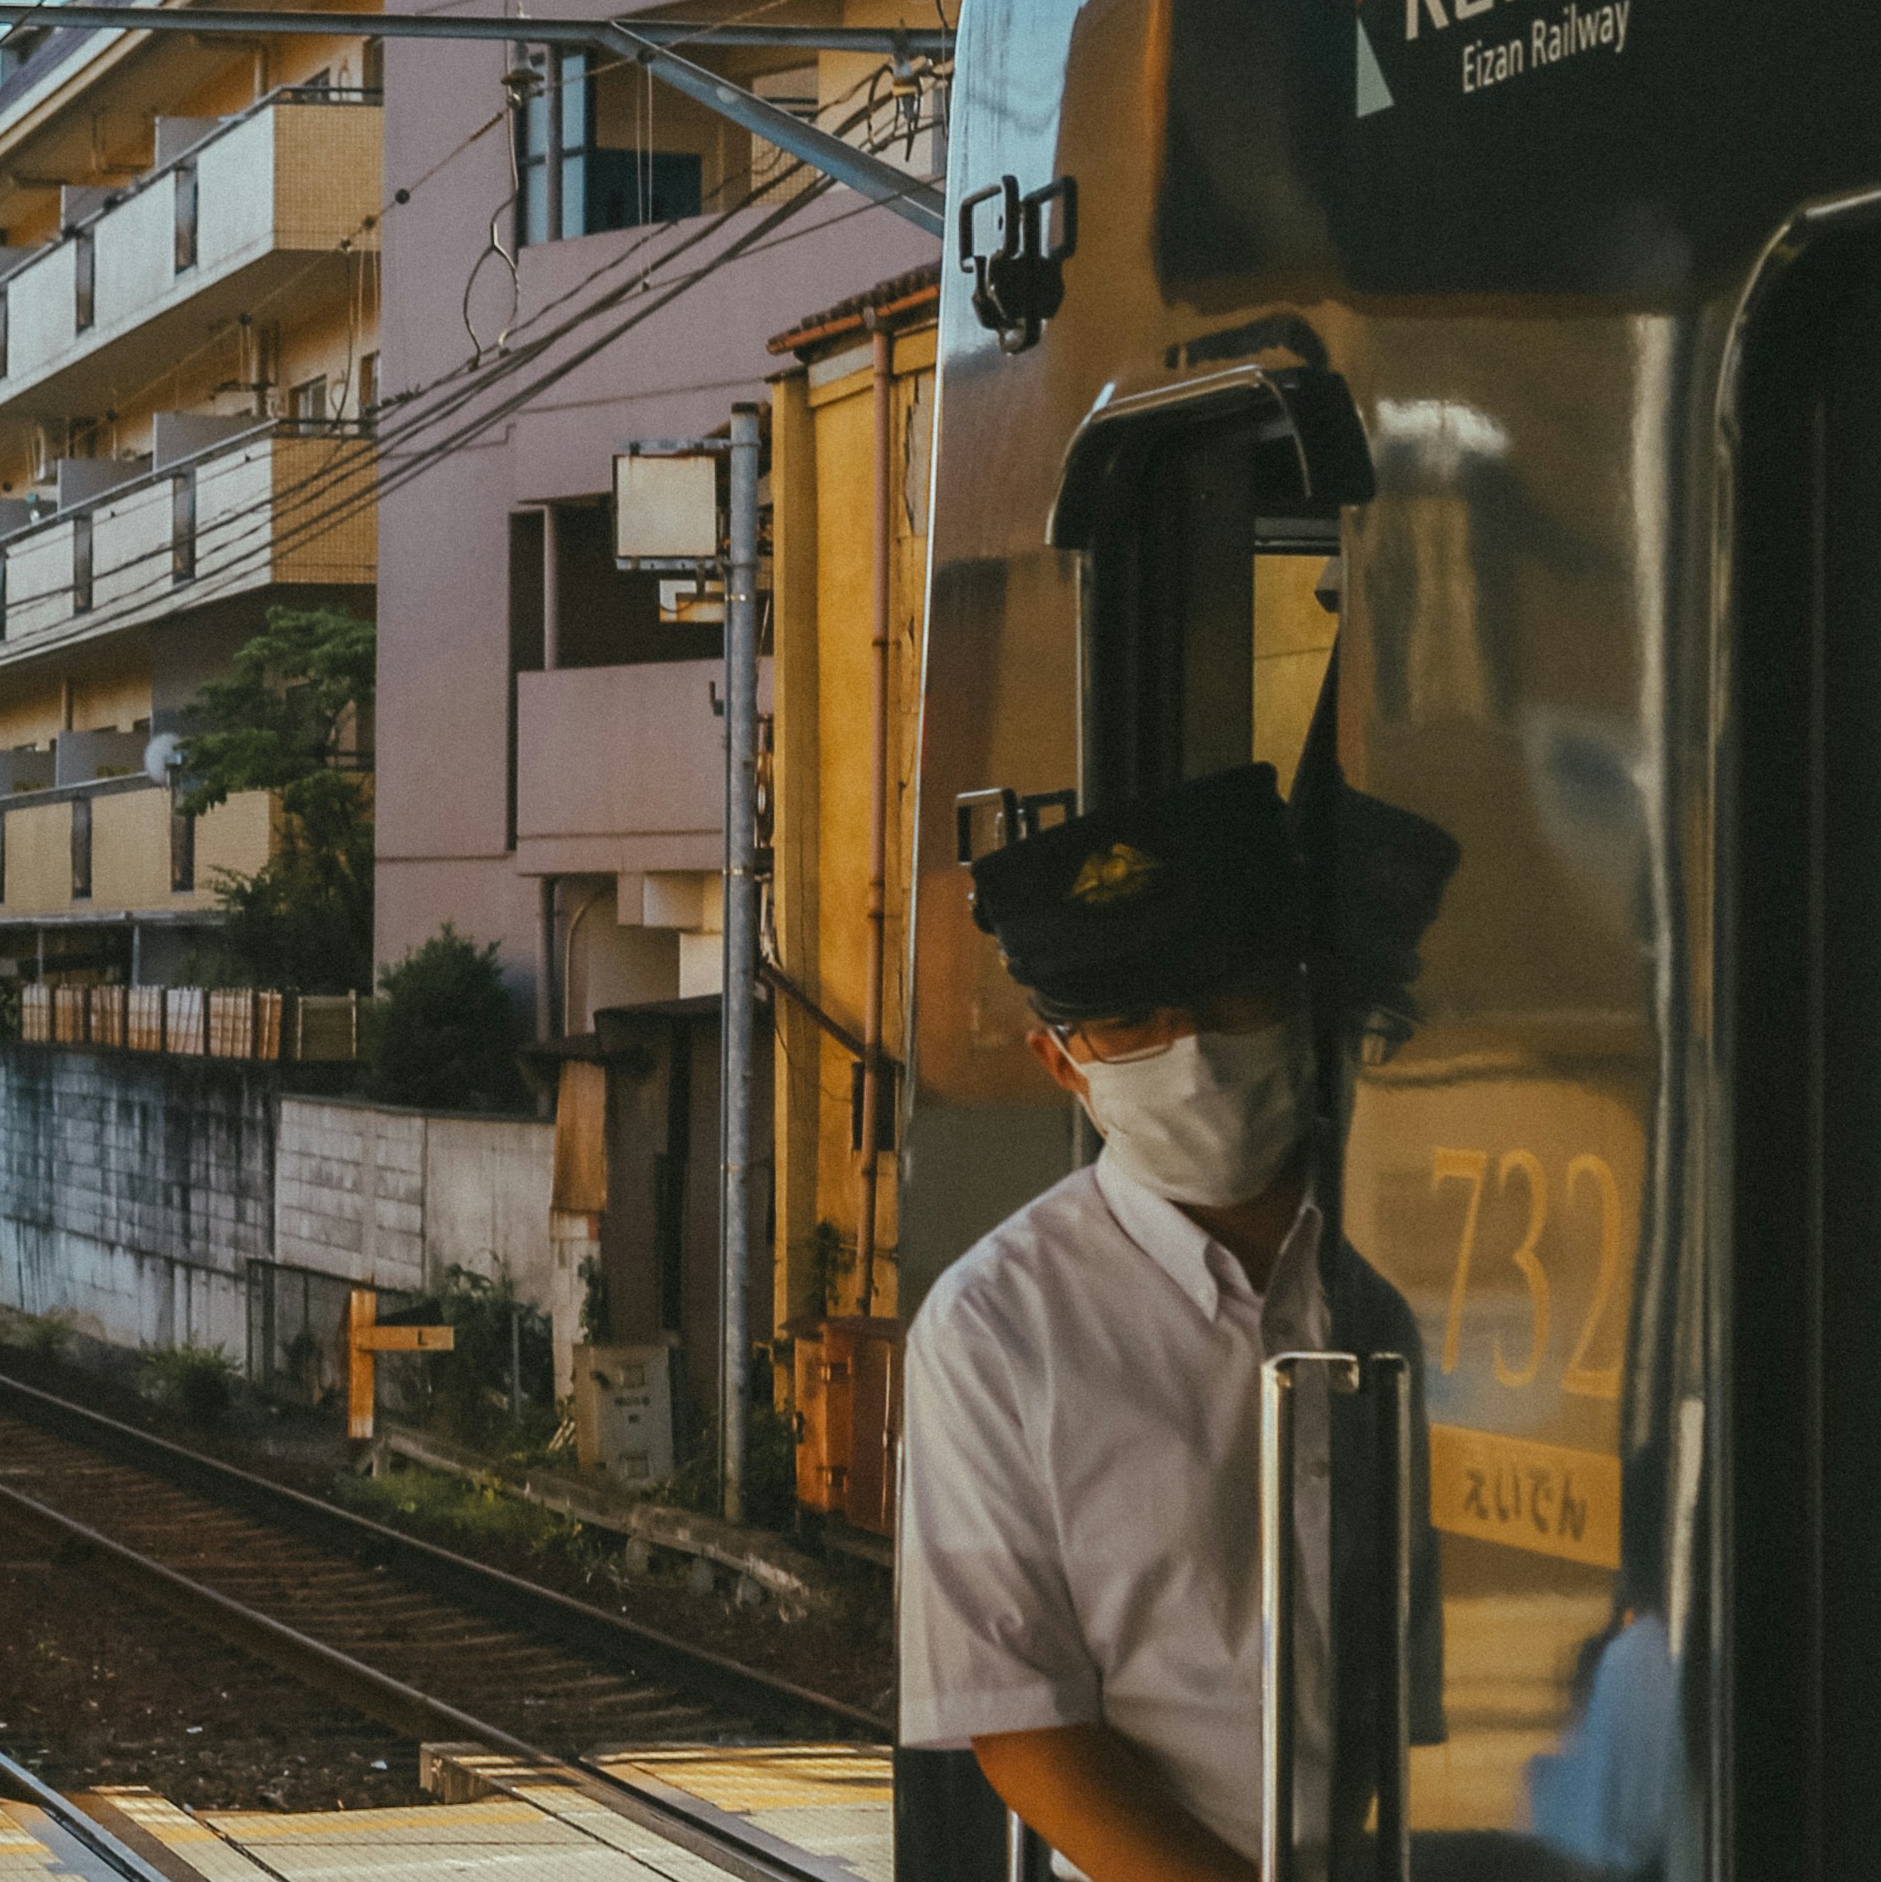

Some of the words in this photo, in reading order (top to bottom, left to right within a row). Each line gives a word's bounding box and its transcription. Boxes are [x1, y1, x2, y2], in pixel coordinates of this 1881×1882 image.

[1462, 39, 1524, 94] Eizan
[1530, 0, 1631, 69] Railway
[1431, 1147, 1619, 1400] 732
[1463, 1469, 1588, 1543] えいでん
